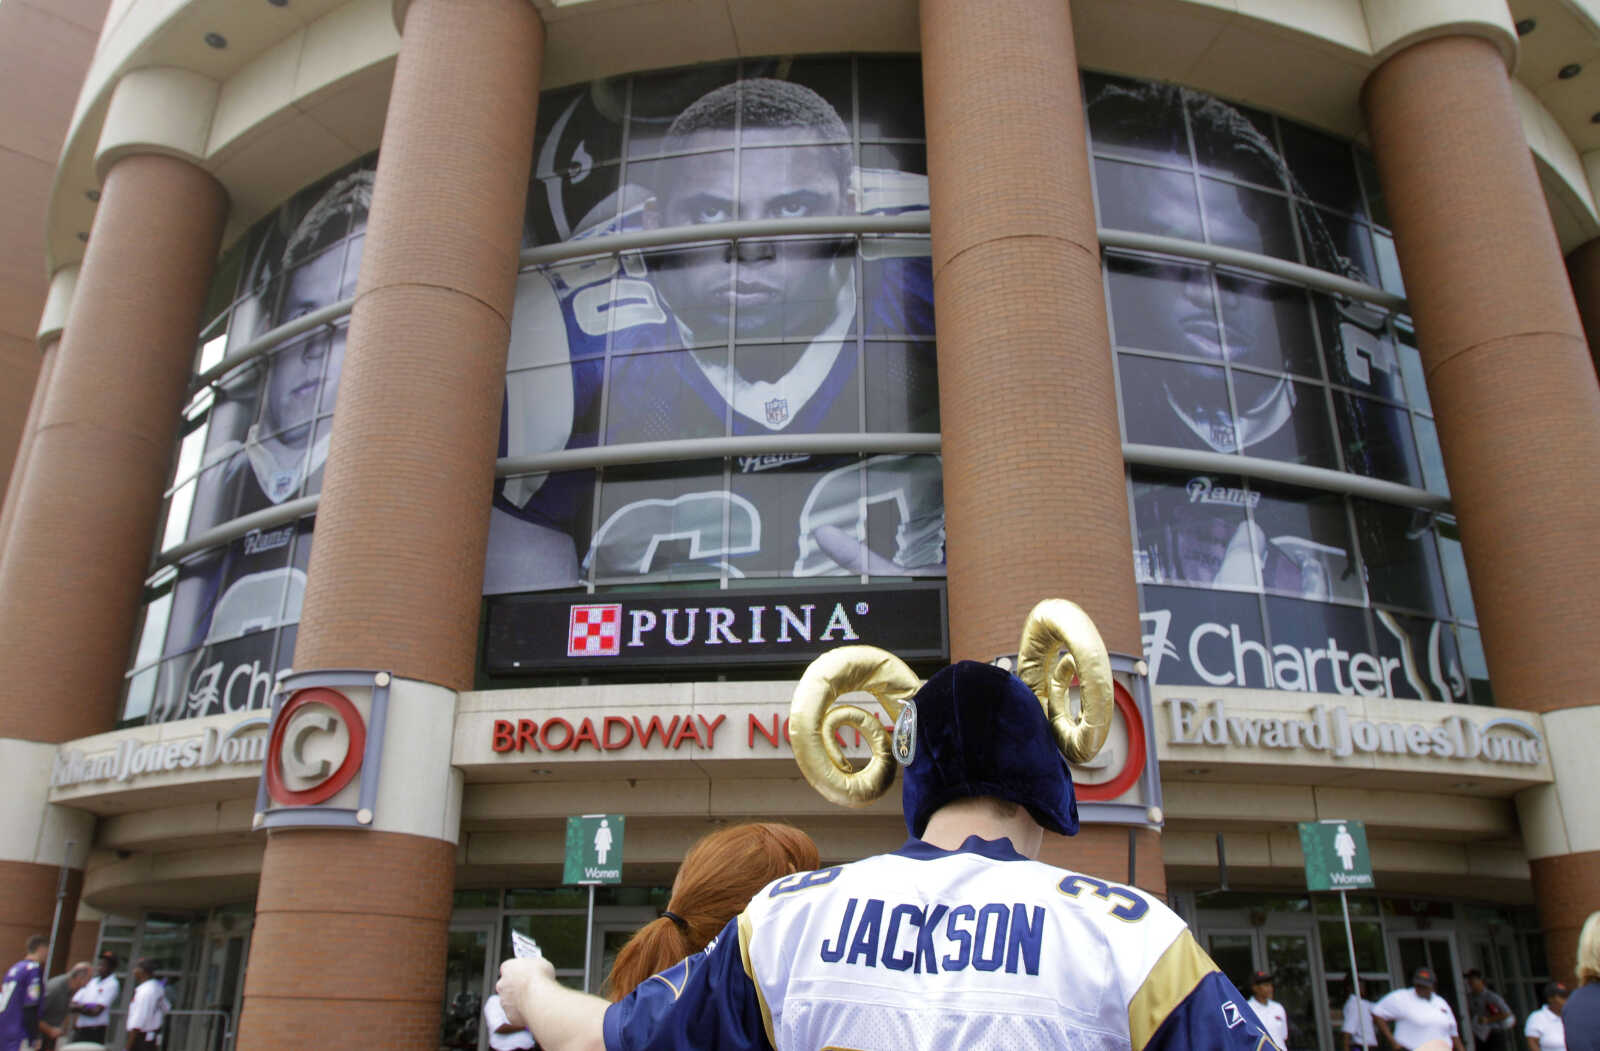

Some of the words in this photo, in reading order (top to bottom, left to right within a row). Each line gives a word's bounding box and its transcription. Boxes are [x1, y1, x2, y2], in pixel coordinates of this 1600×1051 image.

[1188, 622, 1401, 701] Charter
[491, 713, 727, 753] BROADWAY
[584, 867, 619, 879] Women
[1329, 872, 1372, 884] Women
[820, 898, 1046, 976] JACKSON
